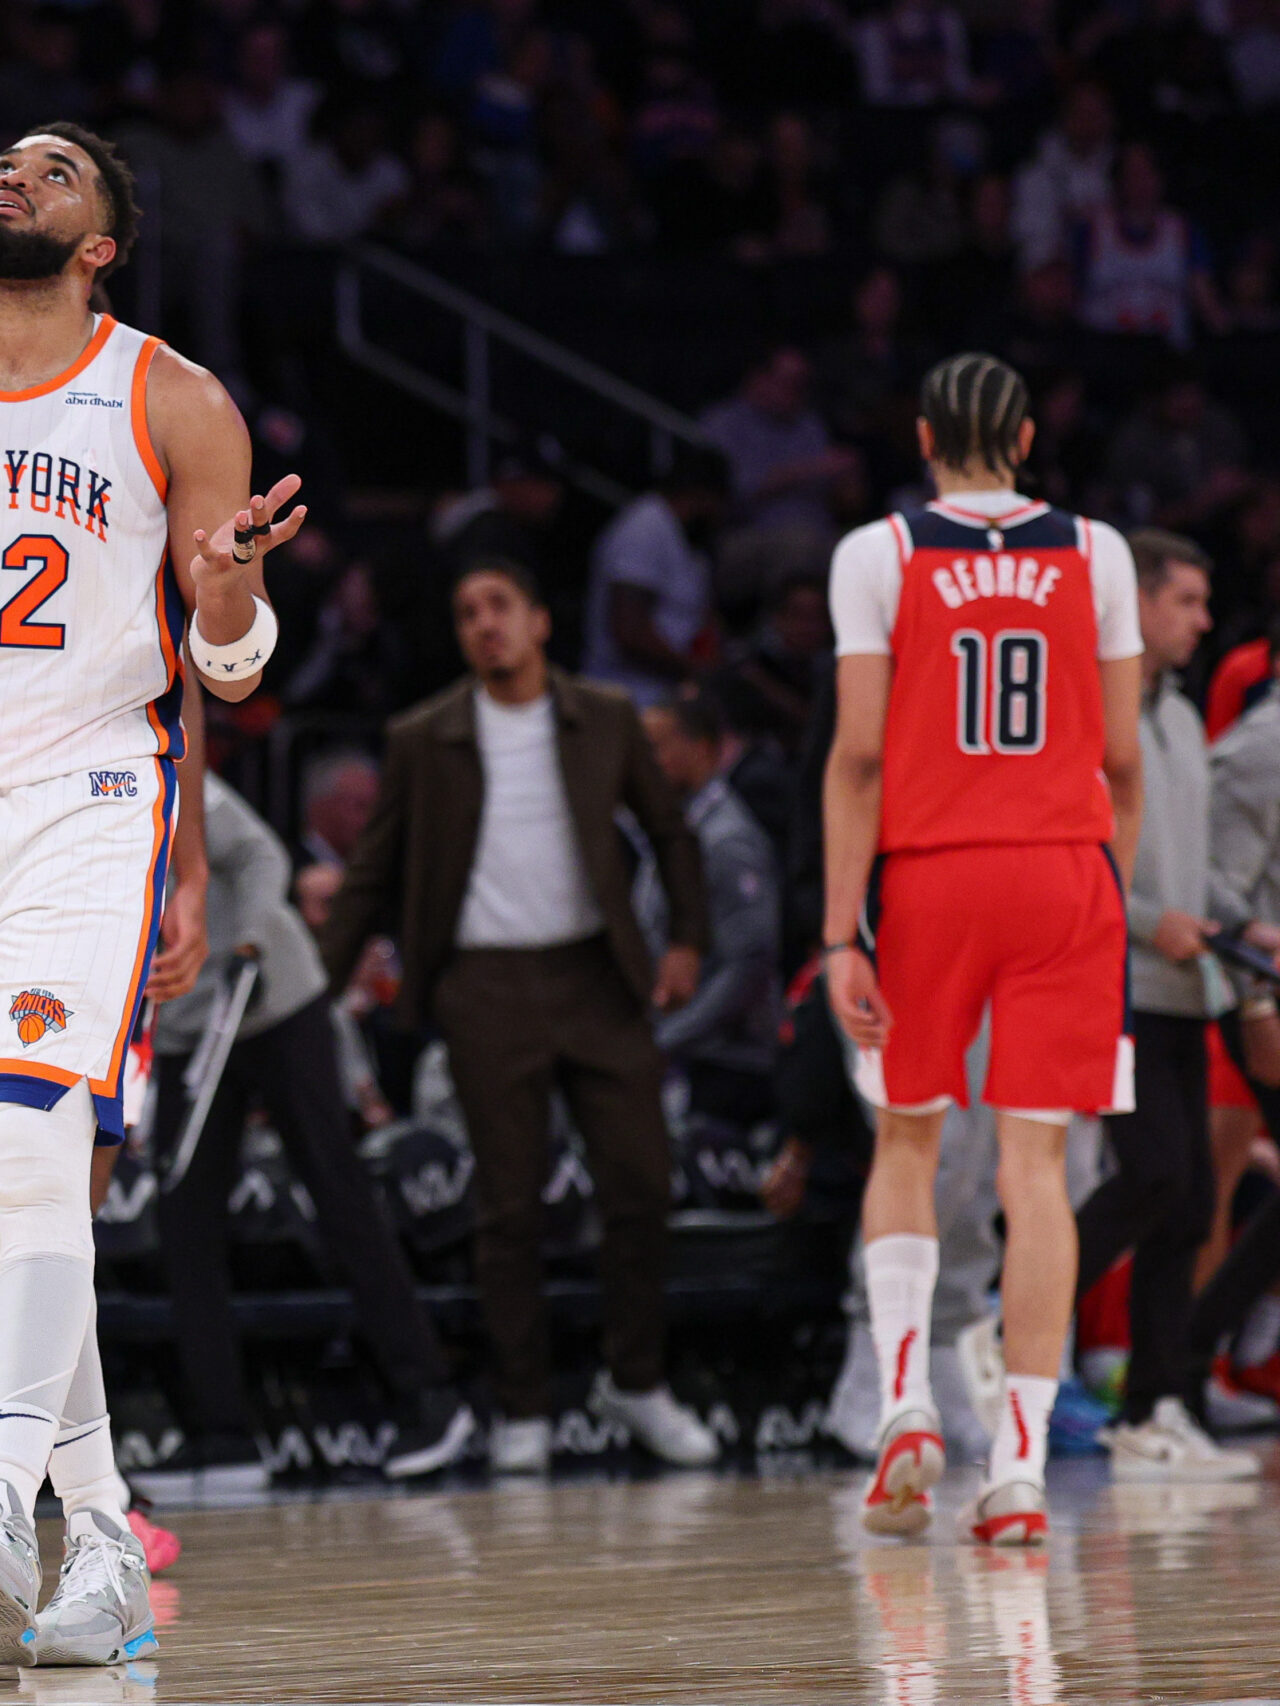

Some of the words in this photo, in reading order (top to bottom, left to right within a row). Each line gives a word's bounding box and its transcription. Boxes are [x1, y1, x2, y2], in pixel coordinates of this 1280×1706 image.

[4, 450, 112, 543] YORK
[932, 554, 1062, 609] GEORGE
[950, 627, 1049, 756] 18
[89, 771, 137, 797] NYC
[9, 991, 67, 1029] KNICKS
